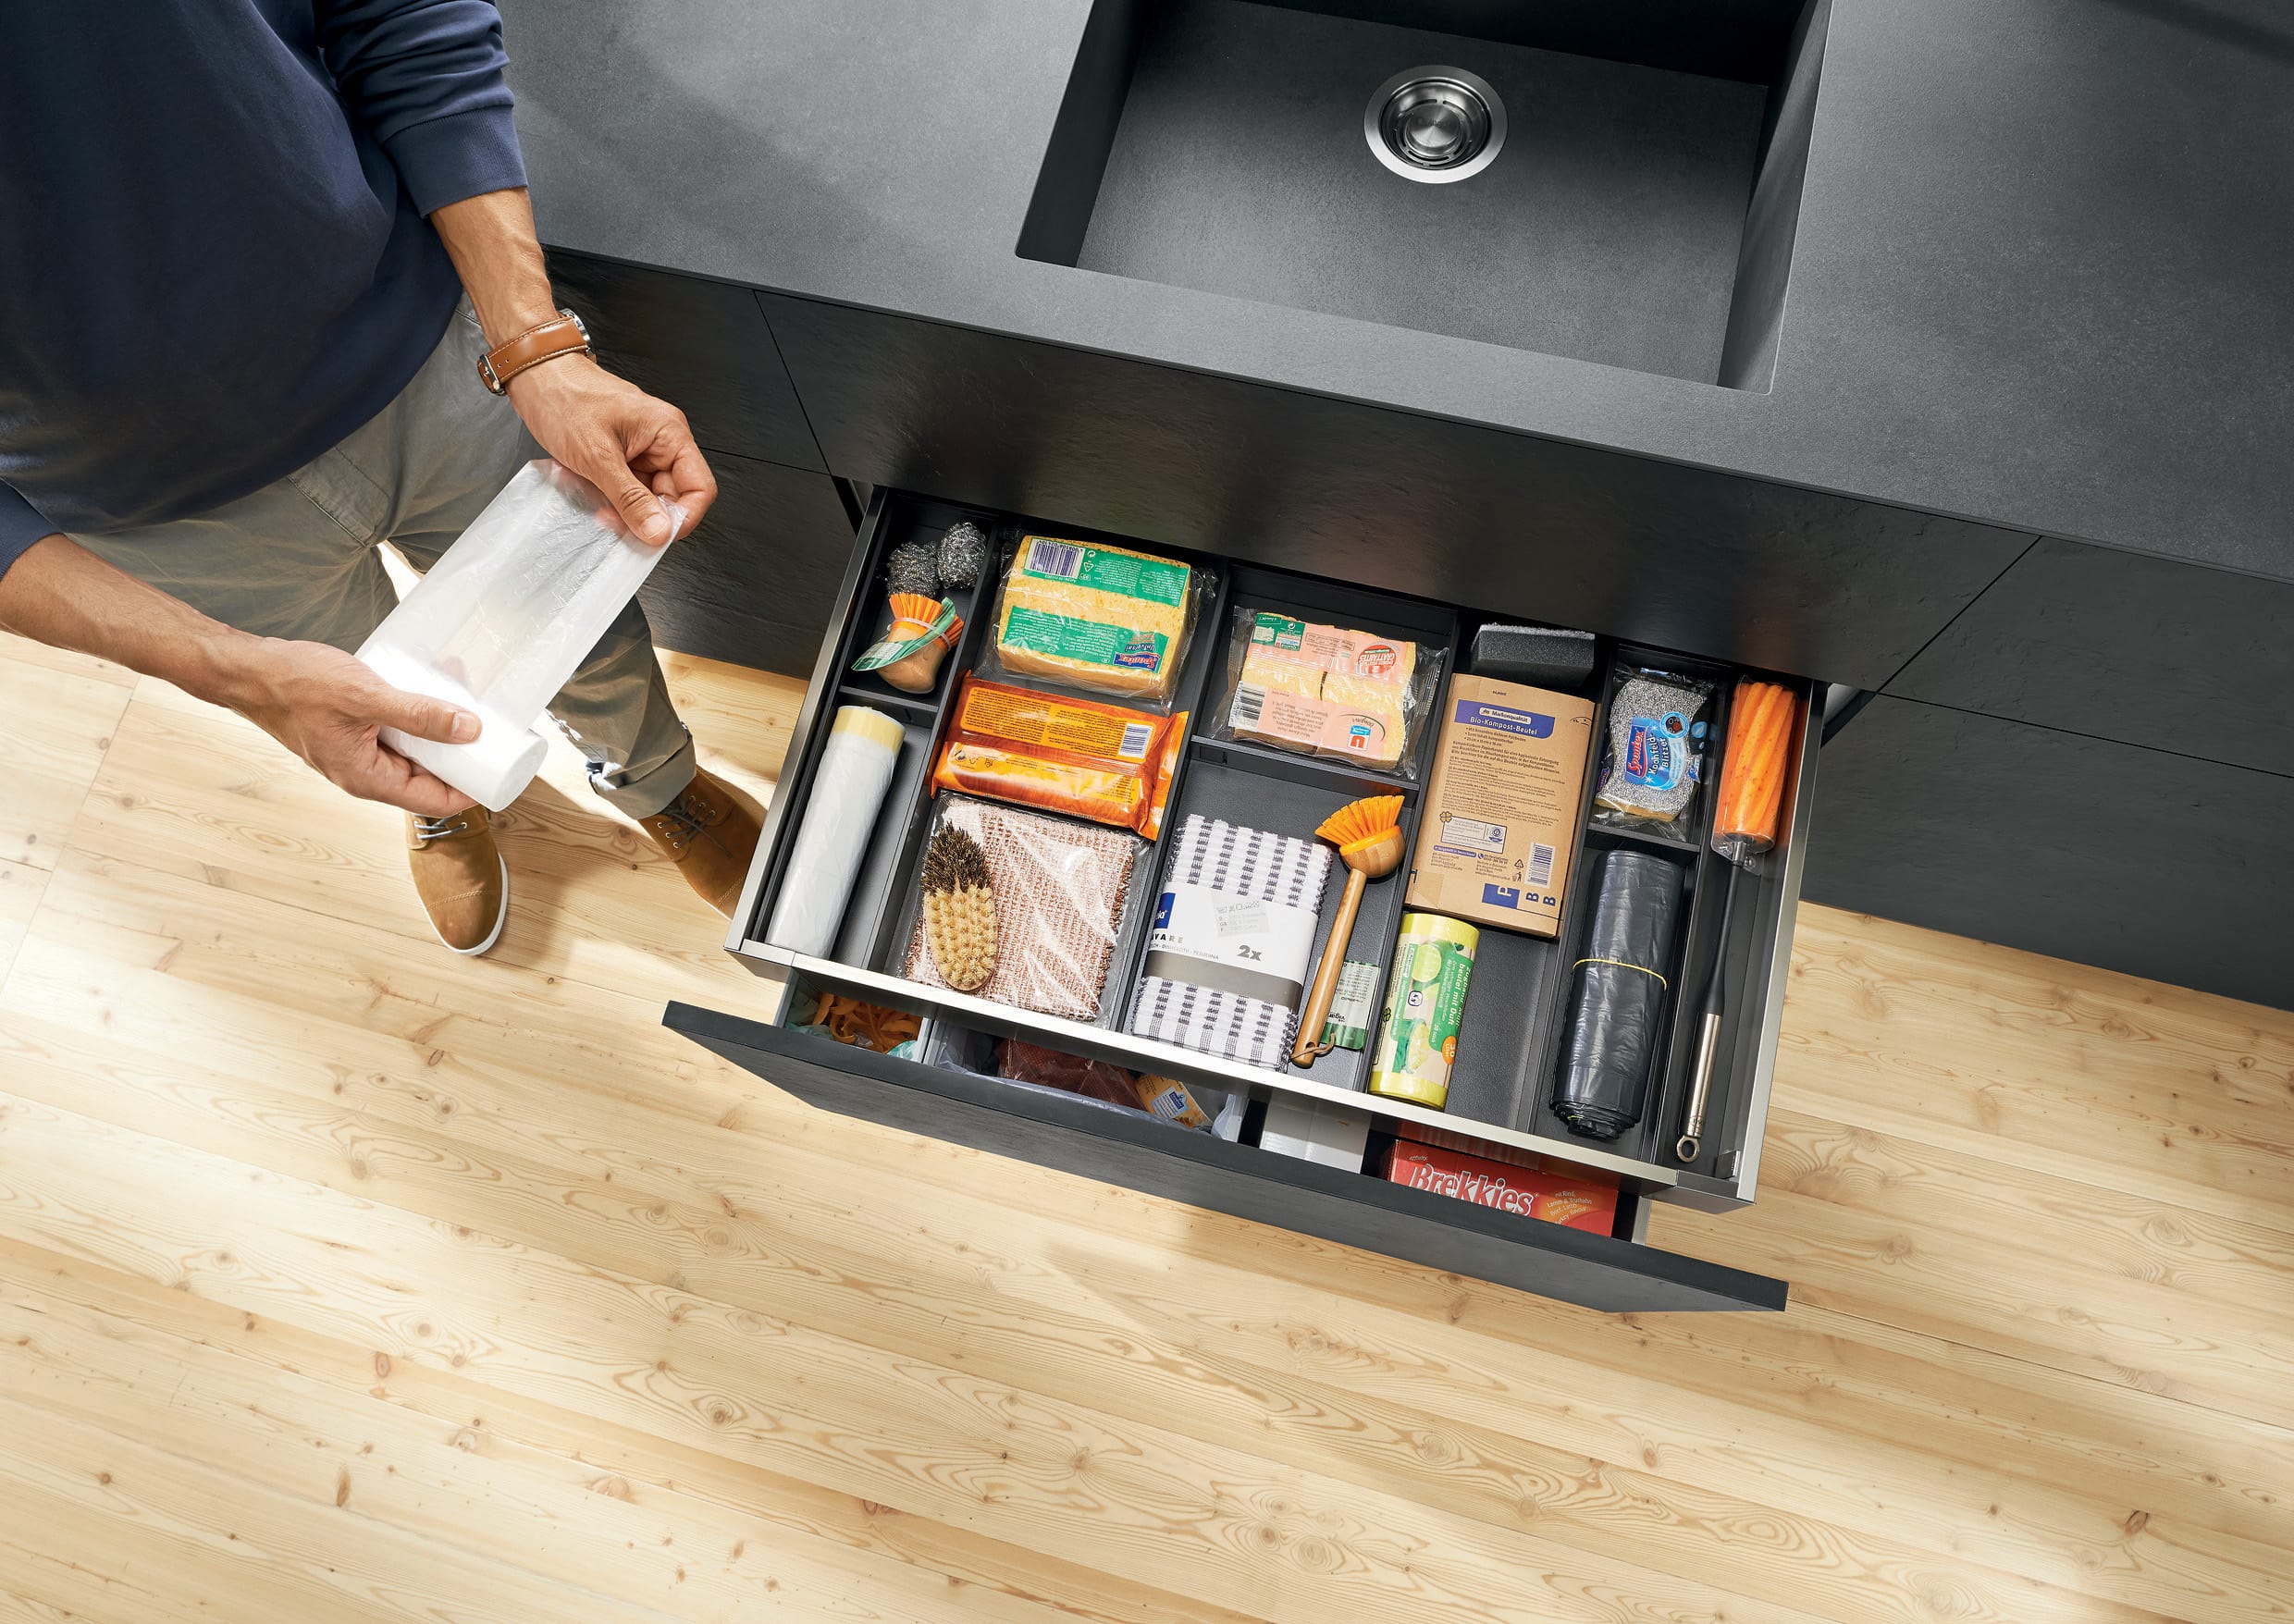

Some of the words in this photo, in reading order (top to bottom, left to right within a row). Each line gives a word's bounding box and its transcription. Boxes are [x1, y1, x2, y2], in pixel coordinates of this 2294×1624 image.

[1118, 653, 1155, 669] Spontex
[1470, 716, 1537, 735] Bio-Kompost-Beutel
[1628, 730, 1644, 775] Spontex
[1646, 732, 1659, 774] Kochfeld-
[1659, 738, 1669, 768] Blitzer
[1237, 944, 1263, 962] 2x
[1455, 963, 1465, 990] beutel
[1451, 991, 1460, 1006] mit
[1448, 1007, 1457, 1026] Duft
[1442, 1042, 1452, 1059] Liter
[1409, 1163, 1535, 1217] Brekkies
